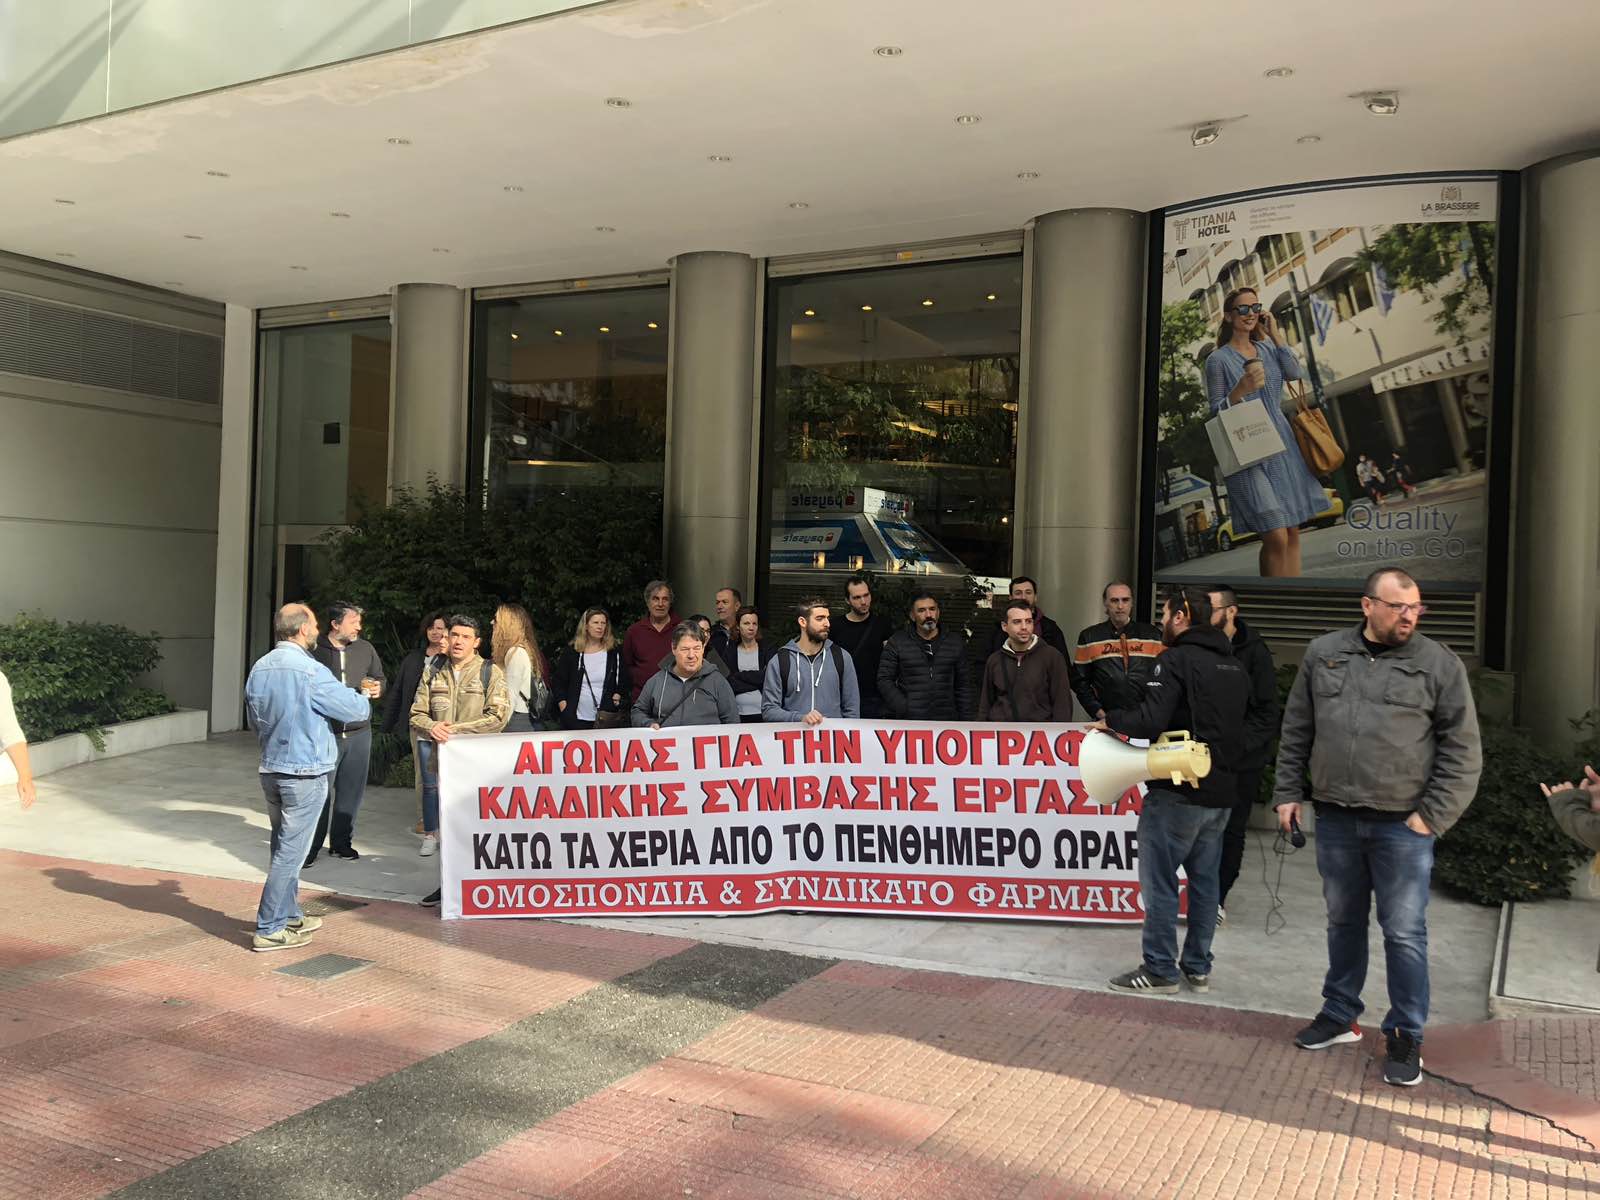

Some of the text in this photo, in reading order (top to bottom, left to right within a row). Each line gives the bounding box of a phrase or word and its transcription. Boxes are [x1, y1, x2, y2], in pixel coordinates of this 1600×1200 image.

[1191, 210, 1236, 229] TITANIA
[1421, 202, 1480, 211] LA BRASSERIE
[1198, 224, 1230, 238] HOTEL
[1346, 504, 1458, 536] Quality
[1337, 537, 1465, 558] on the GO
[513, 738, 679, 775] ΑΓΩΝΑΣ
[692, 733, 762, 770] ΓΙΑ
[775, 729, 862, 765] ΤΗΝ
[479, 775, 1144, 820] ΚΛΑΔΙΚΗΣ ΣΥΜΒΑΣΗΣ ΕΡΓΑΣΑ
[472, 831, 552, 870] ΚΑΤΩ
[561, 831, 600, 869] ΤΑ
[608, 828, 700, 868] ΧΕΡΙΑ
[709, 824, 773, 865] ΑΠΟ
[783, 822, 824, 863] ΤΟ
[834, 824, 1041, 869] ΠΕΝΘΗΜΕΡΟ
[472, 881, 708, 909] ΟΜΟΣΠΟΝΔΙΑ
[719, 880, 742, 906] &
[754, 876, 955, 907] ΣΥΝΔΙΚΑΤΟ
